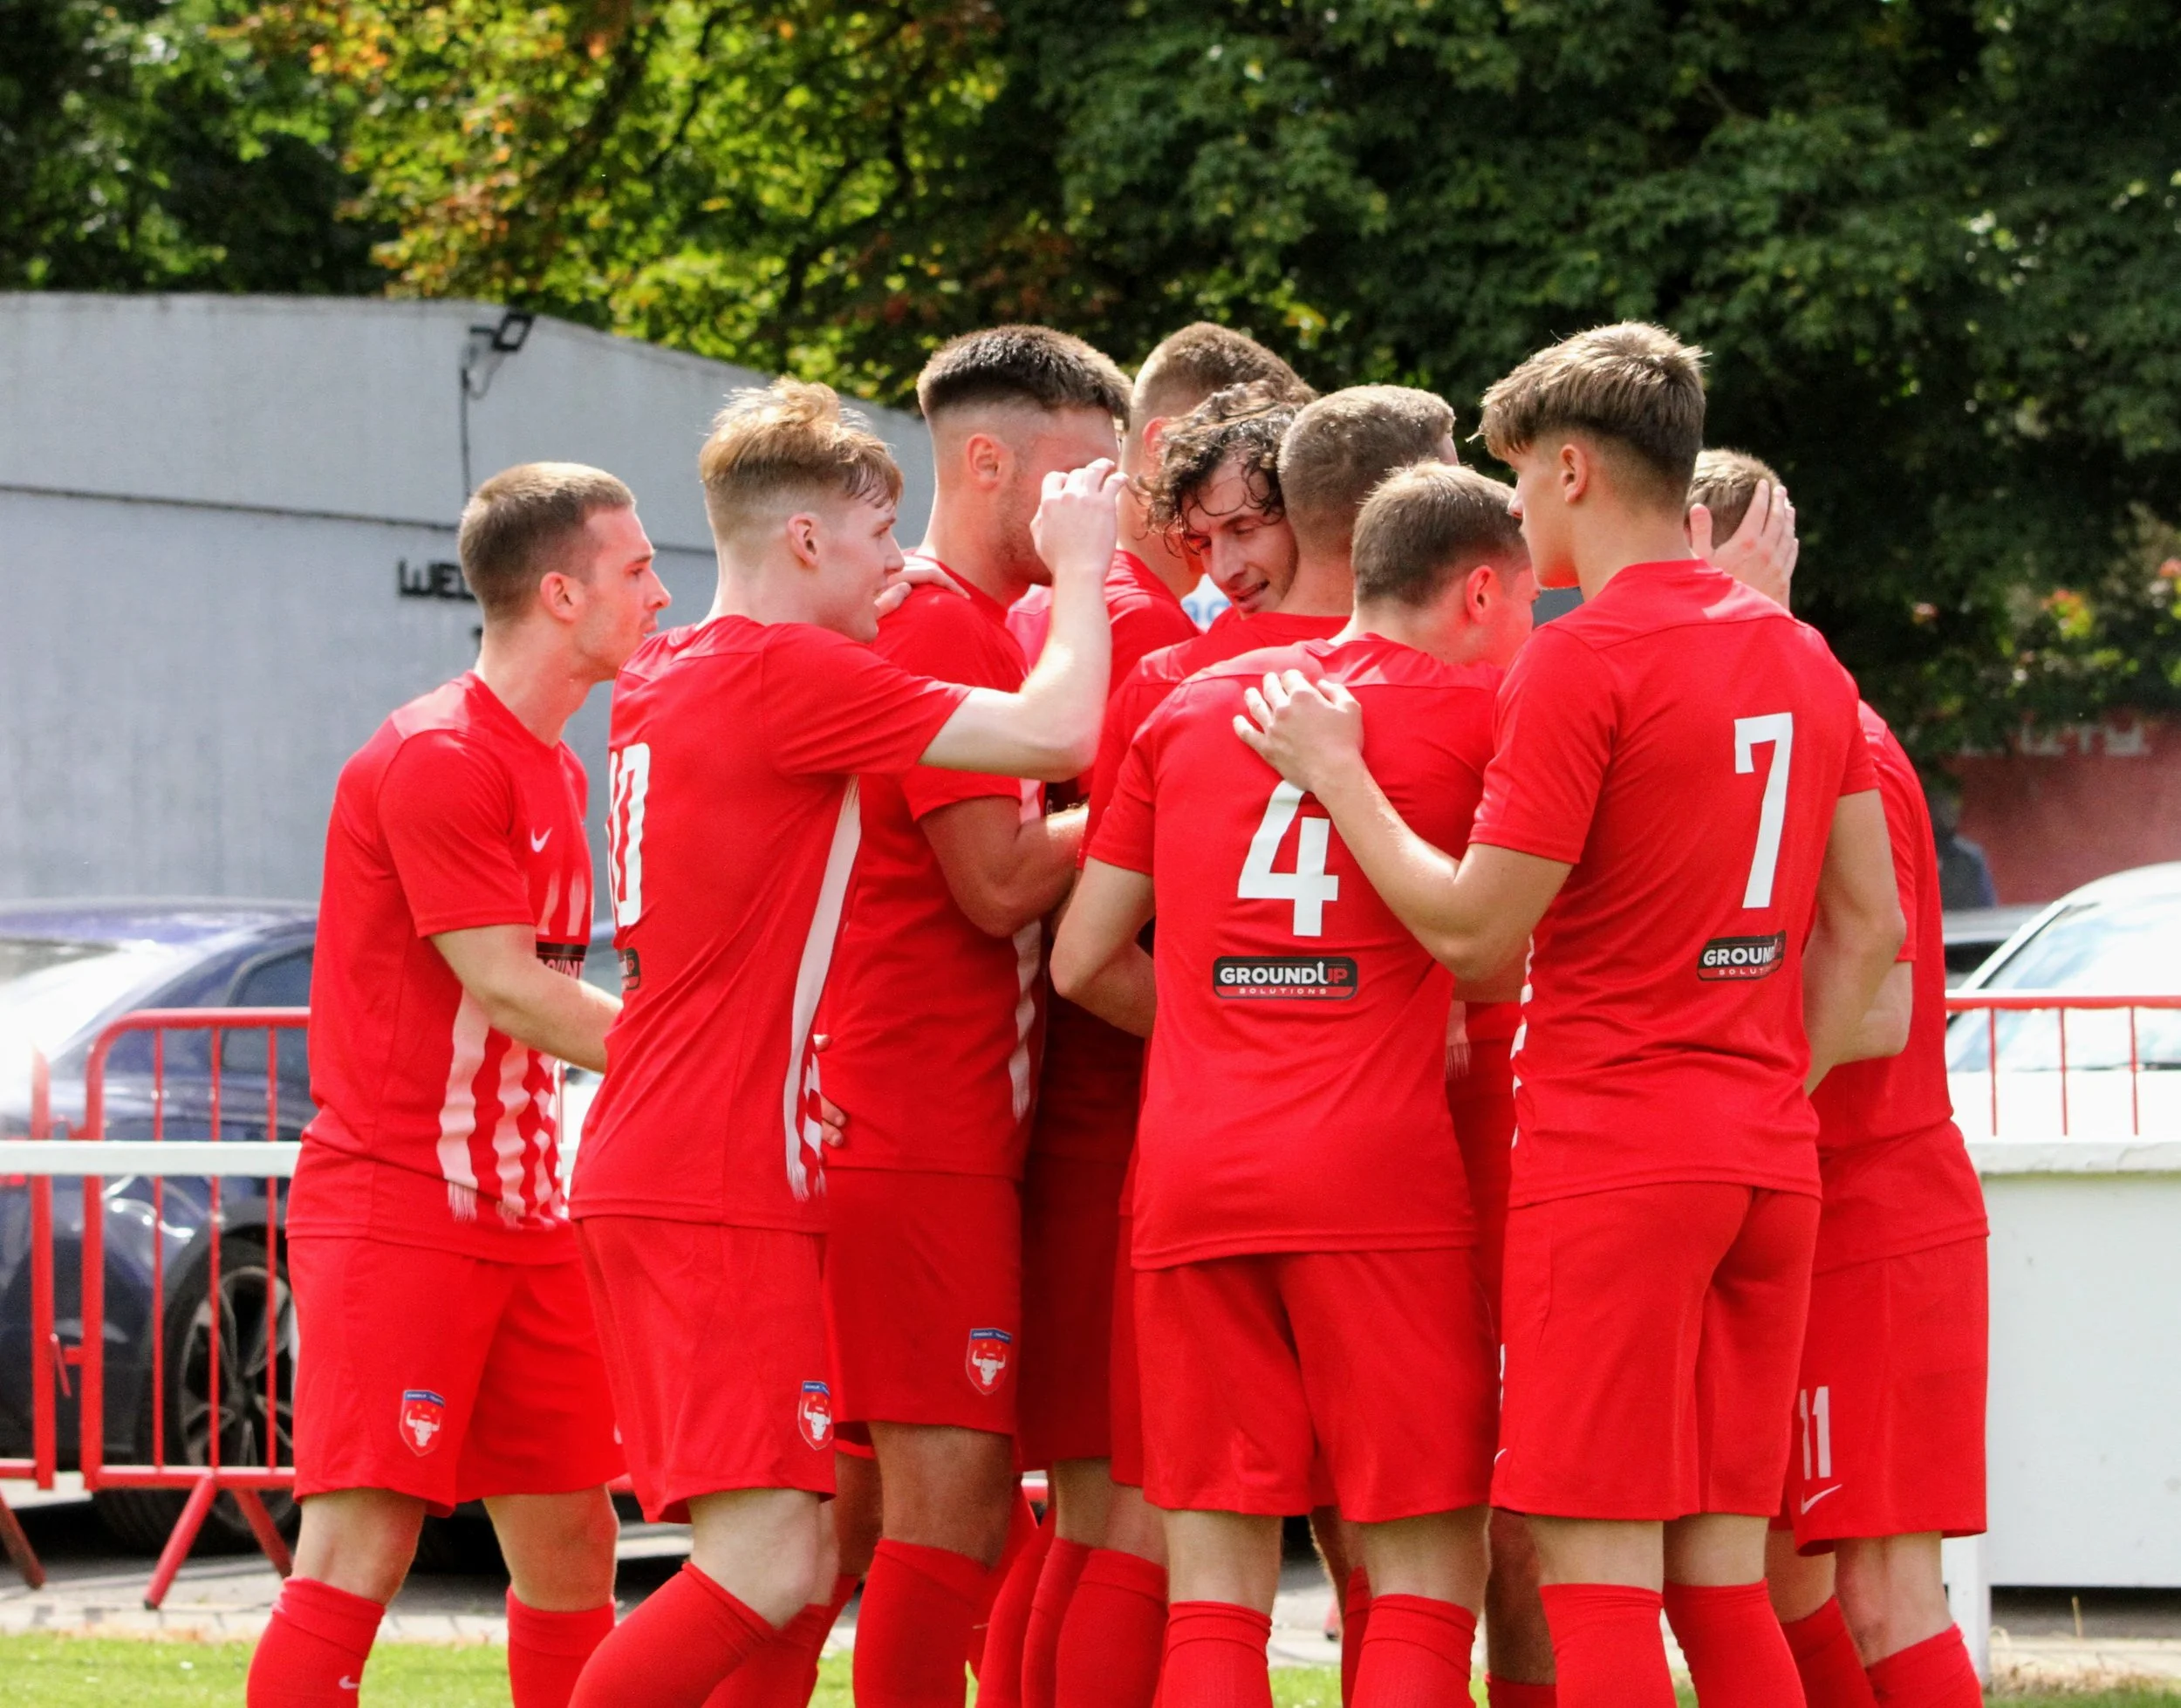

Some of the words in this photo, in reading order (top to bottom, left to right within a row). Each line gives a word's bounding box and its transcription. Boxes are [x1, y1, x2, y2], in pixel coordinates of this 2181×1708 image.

[1237, 779, 1338, 937] 4
[1734, 712, 1794, 908] 7
[1800, 1385, 1831, 1480] 11
